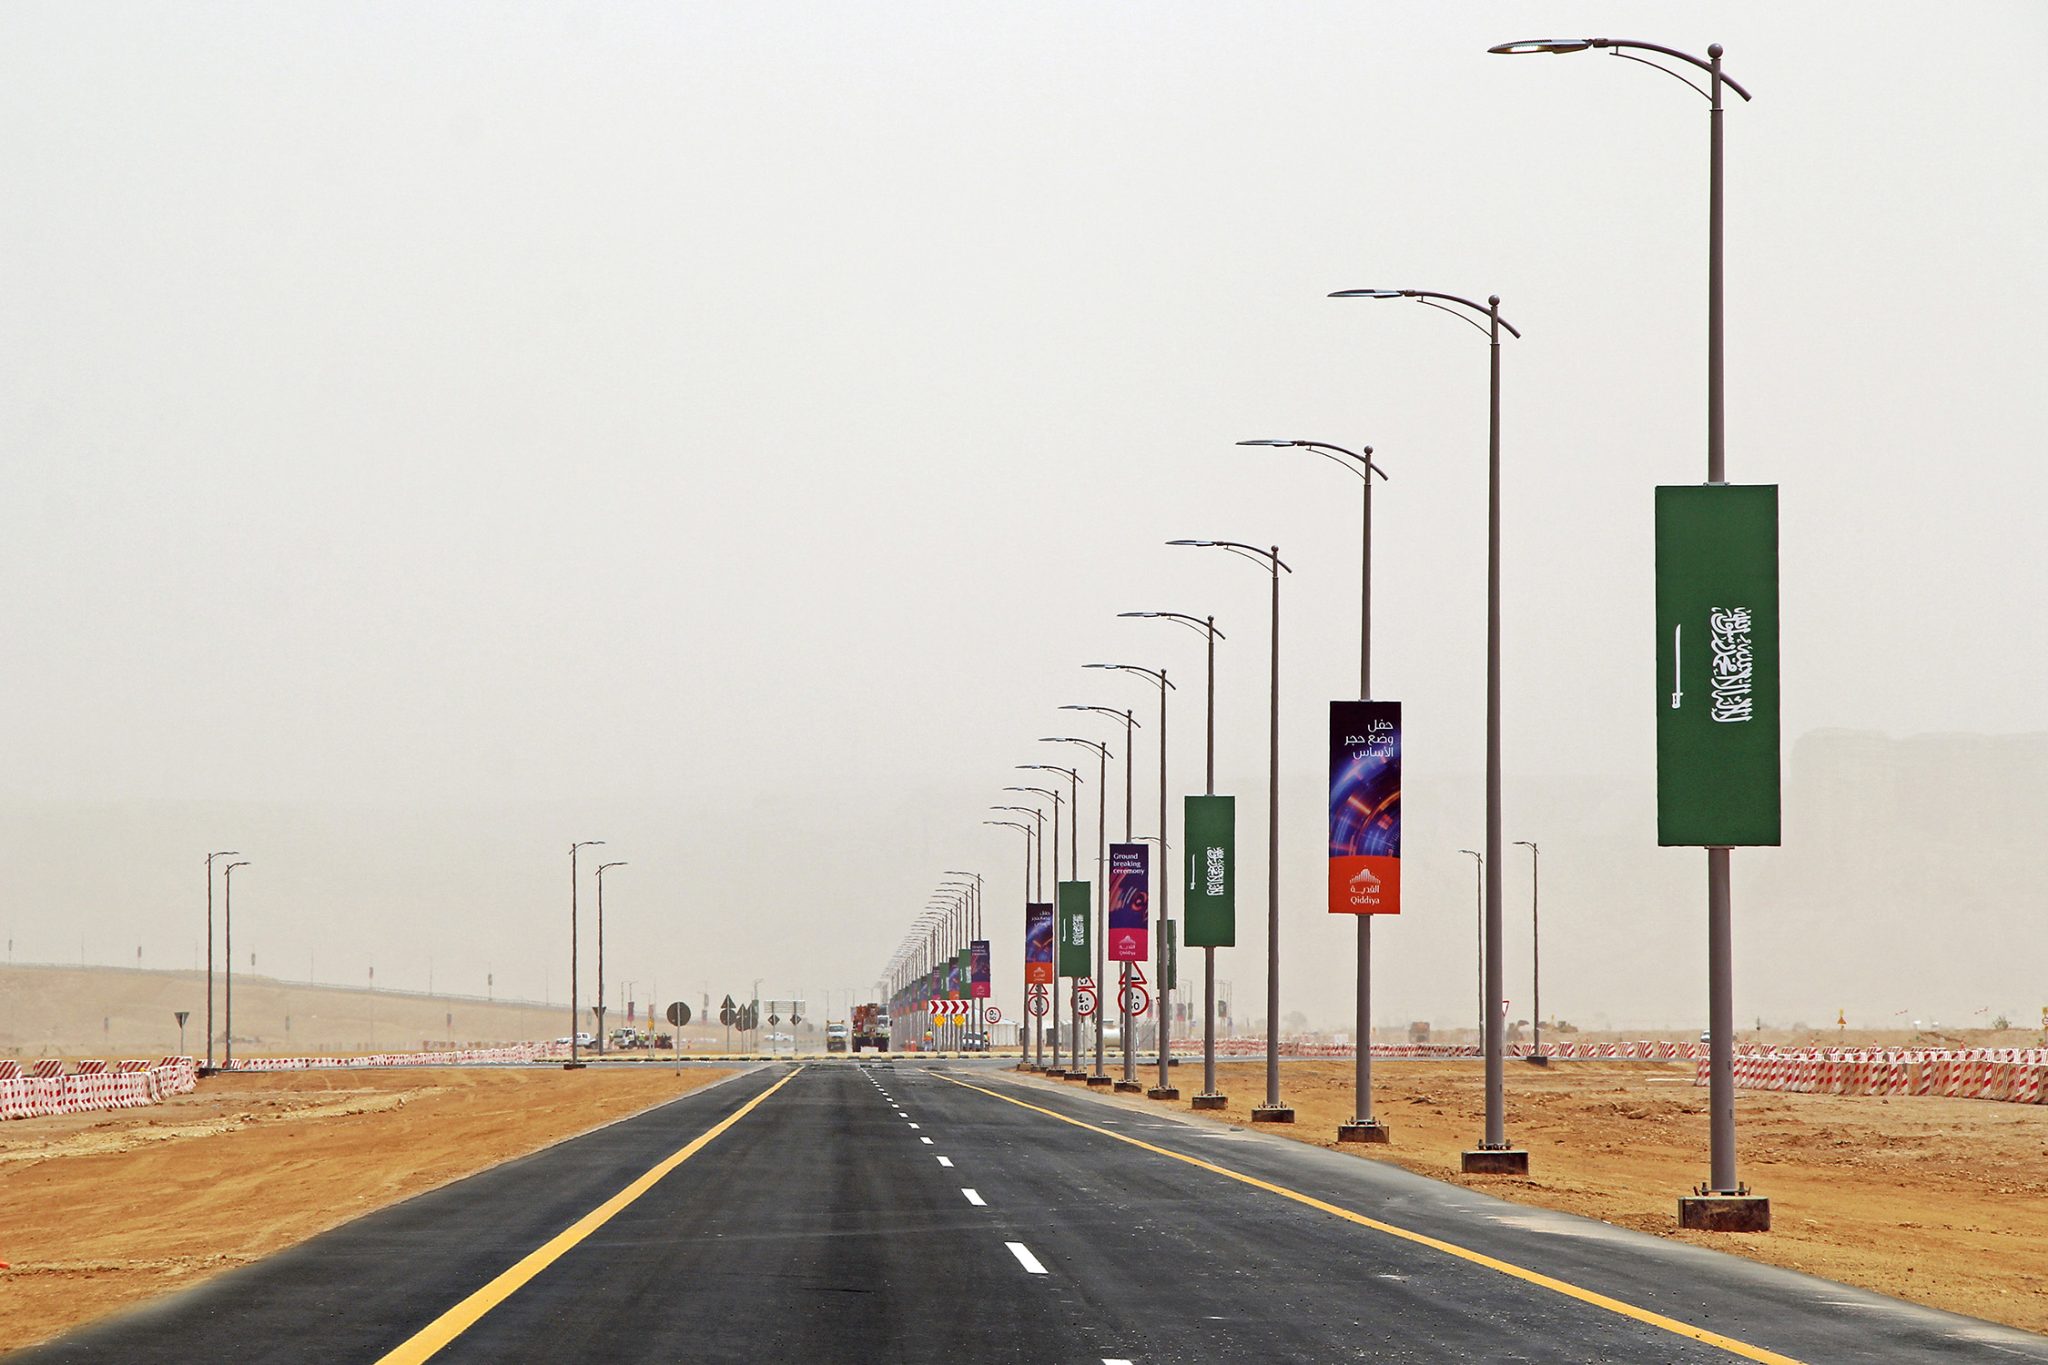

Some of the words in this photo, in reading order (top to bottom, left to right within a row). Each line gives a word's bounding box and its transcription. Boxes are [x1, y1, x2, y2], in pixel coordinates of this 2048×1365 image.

[1367, 719, 1394, 733] حفل
[1344, 735, 1366, 746] حجر
[1367, 733, 1394, 747] وضع
[1113, 868, 1145, 876] ceremony
[1350, 896, 1380, 906] Qiddiya
